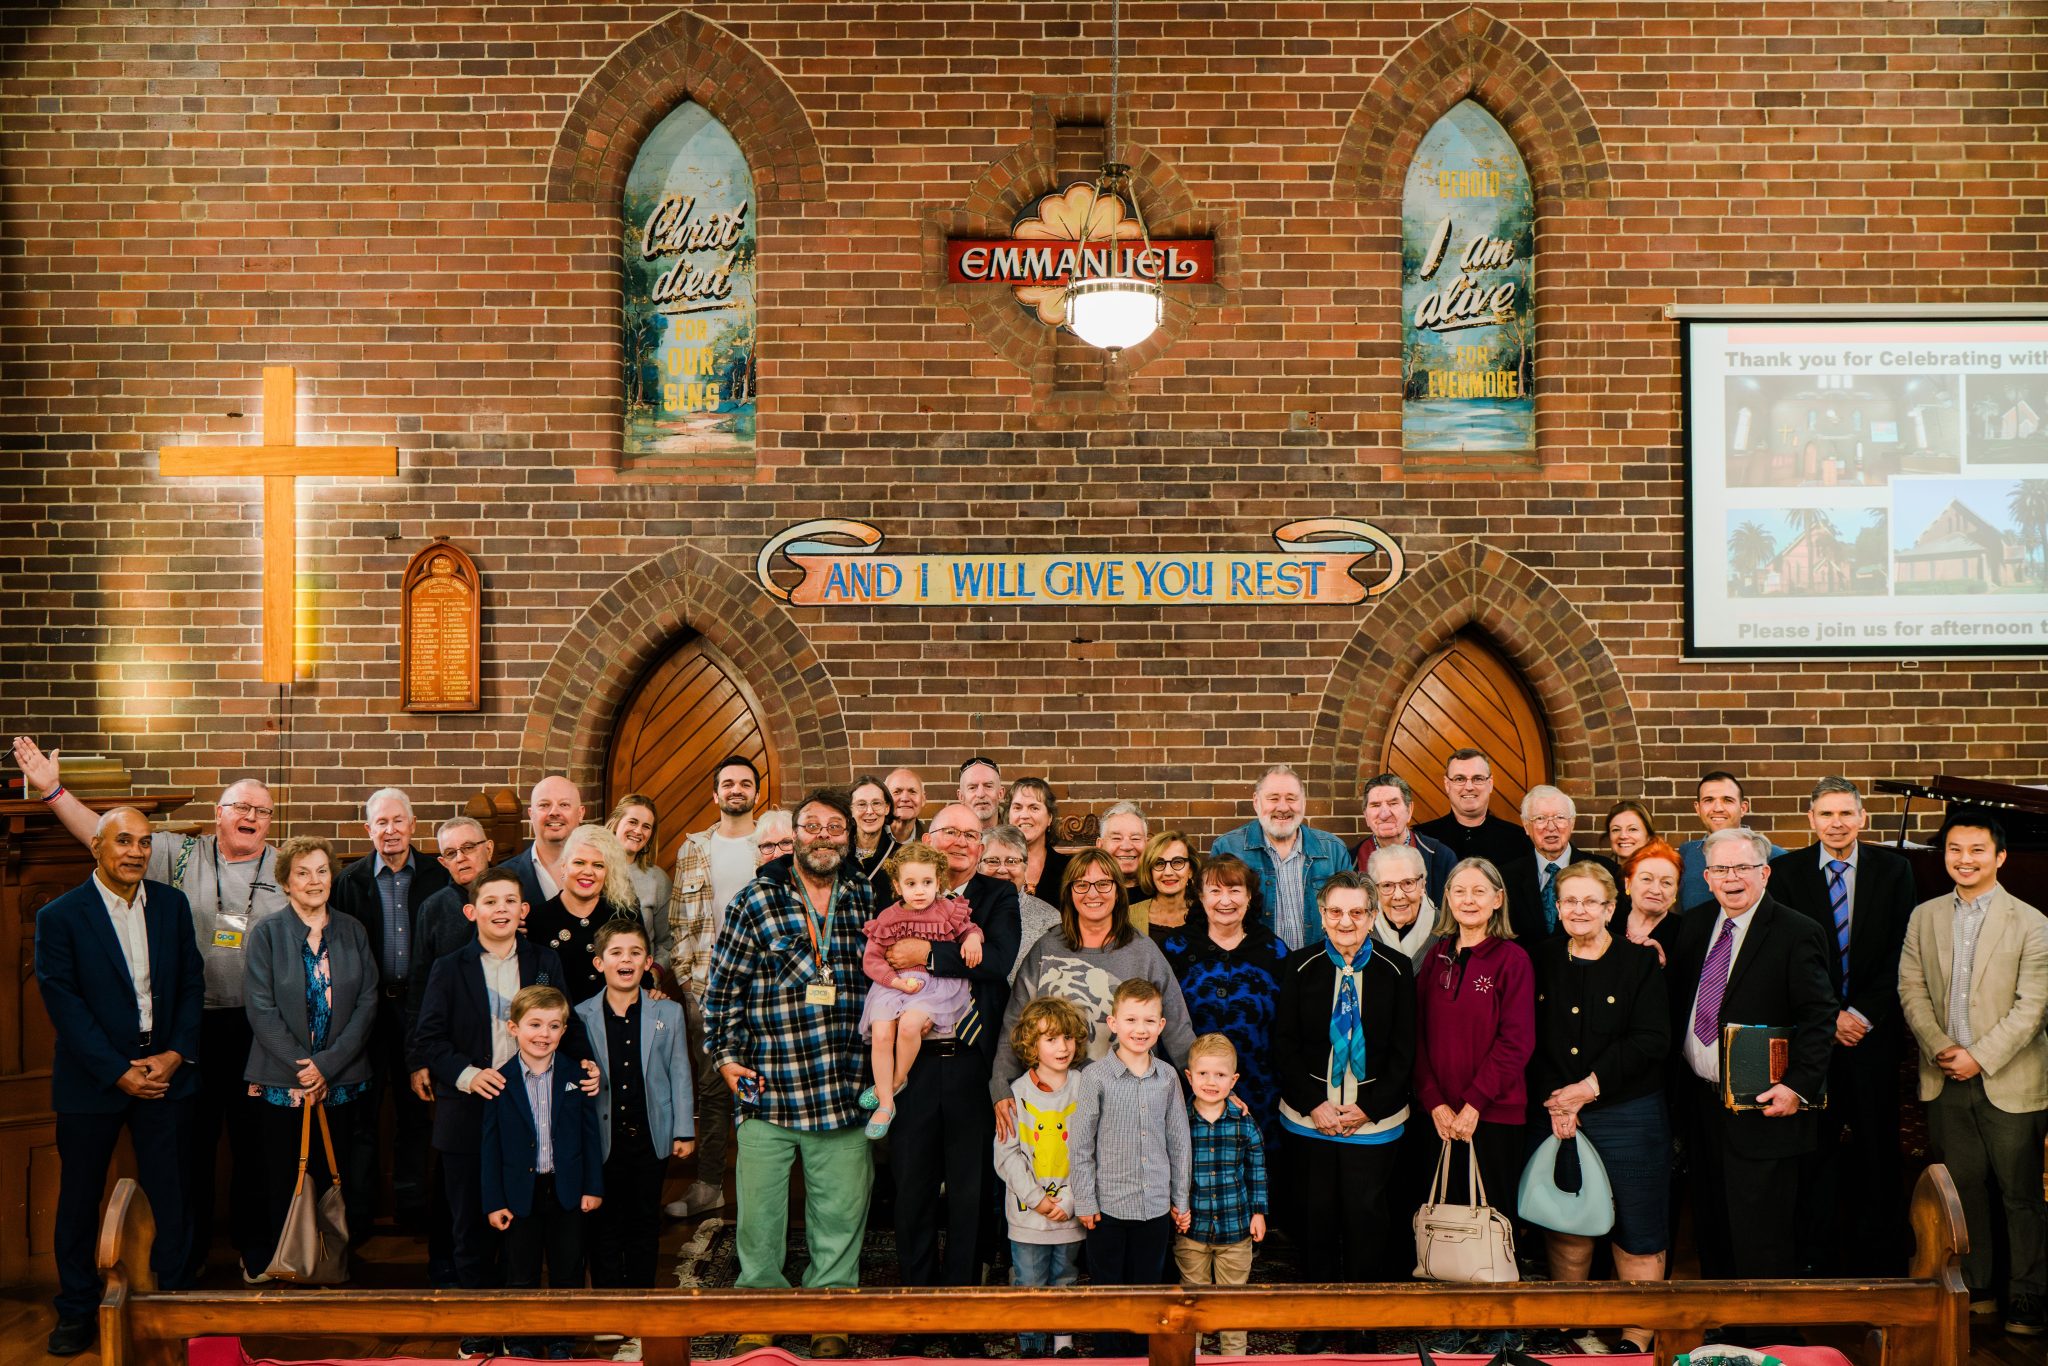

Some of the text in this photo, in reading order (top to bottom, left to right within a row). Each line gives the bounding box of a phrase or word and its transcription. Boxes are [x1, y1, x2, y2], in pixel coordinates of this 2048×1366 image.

[1439, 170, 1500, 198] BEHOLD
[642, 197, 748, 261] Christ
[1420, 214, 1515, 281] I am
[651, 251, 738, 305] died
[960, 246, 1199, 281] EMMANUEL
[1414, 273, 1516, 328] alive
[675, 319, 708, 341] FOR
[667, 347, 715, 376] OUR
[1456, 346, 1489, 364] FOR
[1724, 351, 1792, 367] Thank
[1799, 354, 1836, 370] you
[1843, 350, 1873, 366] for
[1879, 350, 2003, 370] Celebrating
[663, 382, 721, 412] SINS
[1428, 370, 1518, 399] EVERMORE
[823, 560, 1327, 598] AND I WILL GIVE YOU REST
[1738, 623, 1810, 638] Please
[1815, 622, 1856, 641] join
[1863, 624, 1888, 637] us
[1894, 621, 1924, 636] for
[1930, 619, 2034, 636] afternoon
